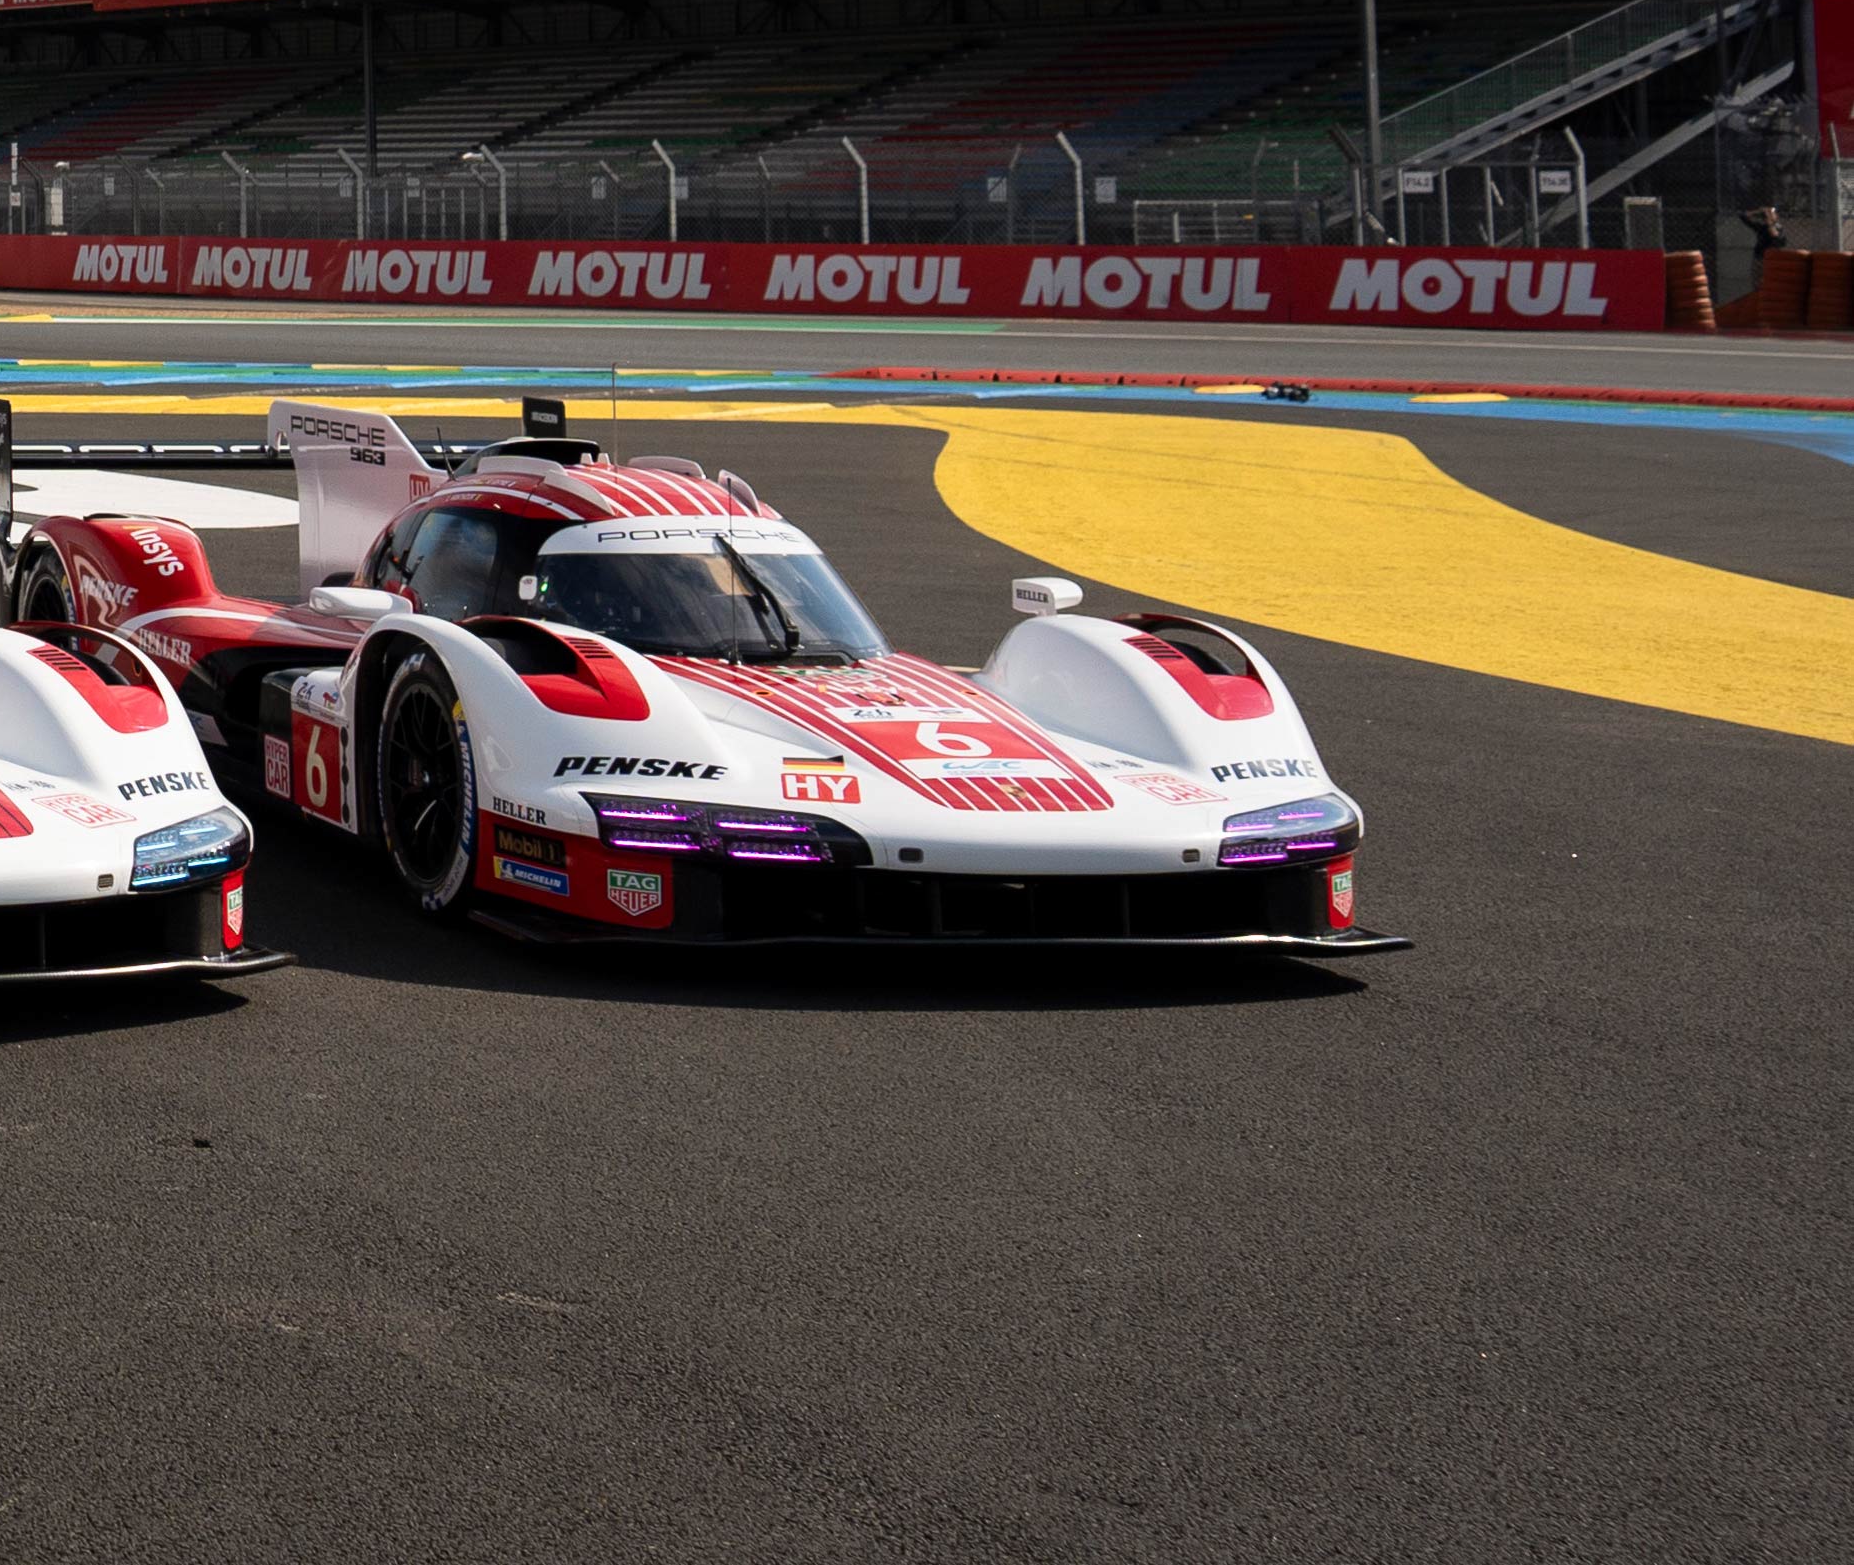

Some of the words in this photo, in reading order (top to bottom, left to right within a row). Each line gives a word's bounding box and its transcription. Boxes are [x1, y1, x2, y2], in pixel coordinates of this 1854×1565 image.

[73, 244, 167, 283] MOTUL
[192, 246, 312, 291] MOTUL
[342, 249, 492, 295] MOTUL
[527, 251, 712, 300] MOTUL
[764, 254, 971, 305] MOTUL
[1021, 256, 1271, 311] MOTUL
[1329, 259, 1608, 317] MOTUL
[290, 414, 386, 448] PORSCHE
[350, 447, 386, 467] 963
[599, 529, 803, 545] PORSCHE
[121, 525, 185, 577] Ansys
[80, 575, 139, 608] PENSKE
[1015, 588, 1049, 604] HELLER
[138, 629, 193, 664] HELLER
[265, 736, 290, 762] HYPER
[914, 722, 991, 757] 6
[265, 757, 290, 796] CAR
[306, 725, 328, 807] 6
[553, 756, 728, 781] PENSKE
[943, 760, 1022, 772] WEC
[1212, 759, 1319, 784] PENSKE
[118, 771, 210, 801] PENSKE
[460, 740, 477, 846] MICHELIN
[784, 775, 854, 801] HY
[1147, 786, 1210, 802] CAR
[63, 803, 122, 826] CAR
[492, 797, 547, 826] HELLER
[498, 830, 541, 860] Mobil
[514, 868, 562, 889] MICHELIN
[612, 873, 657, 889] TAG
[610, 889, 659, 913] HEUER
